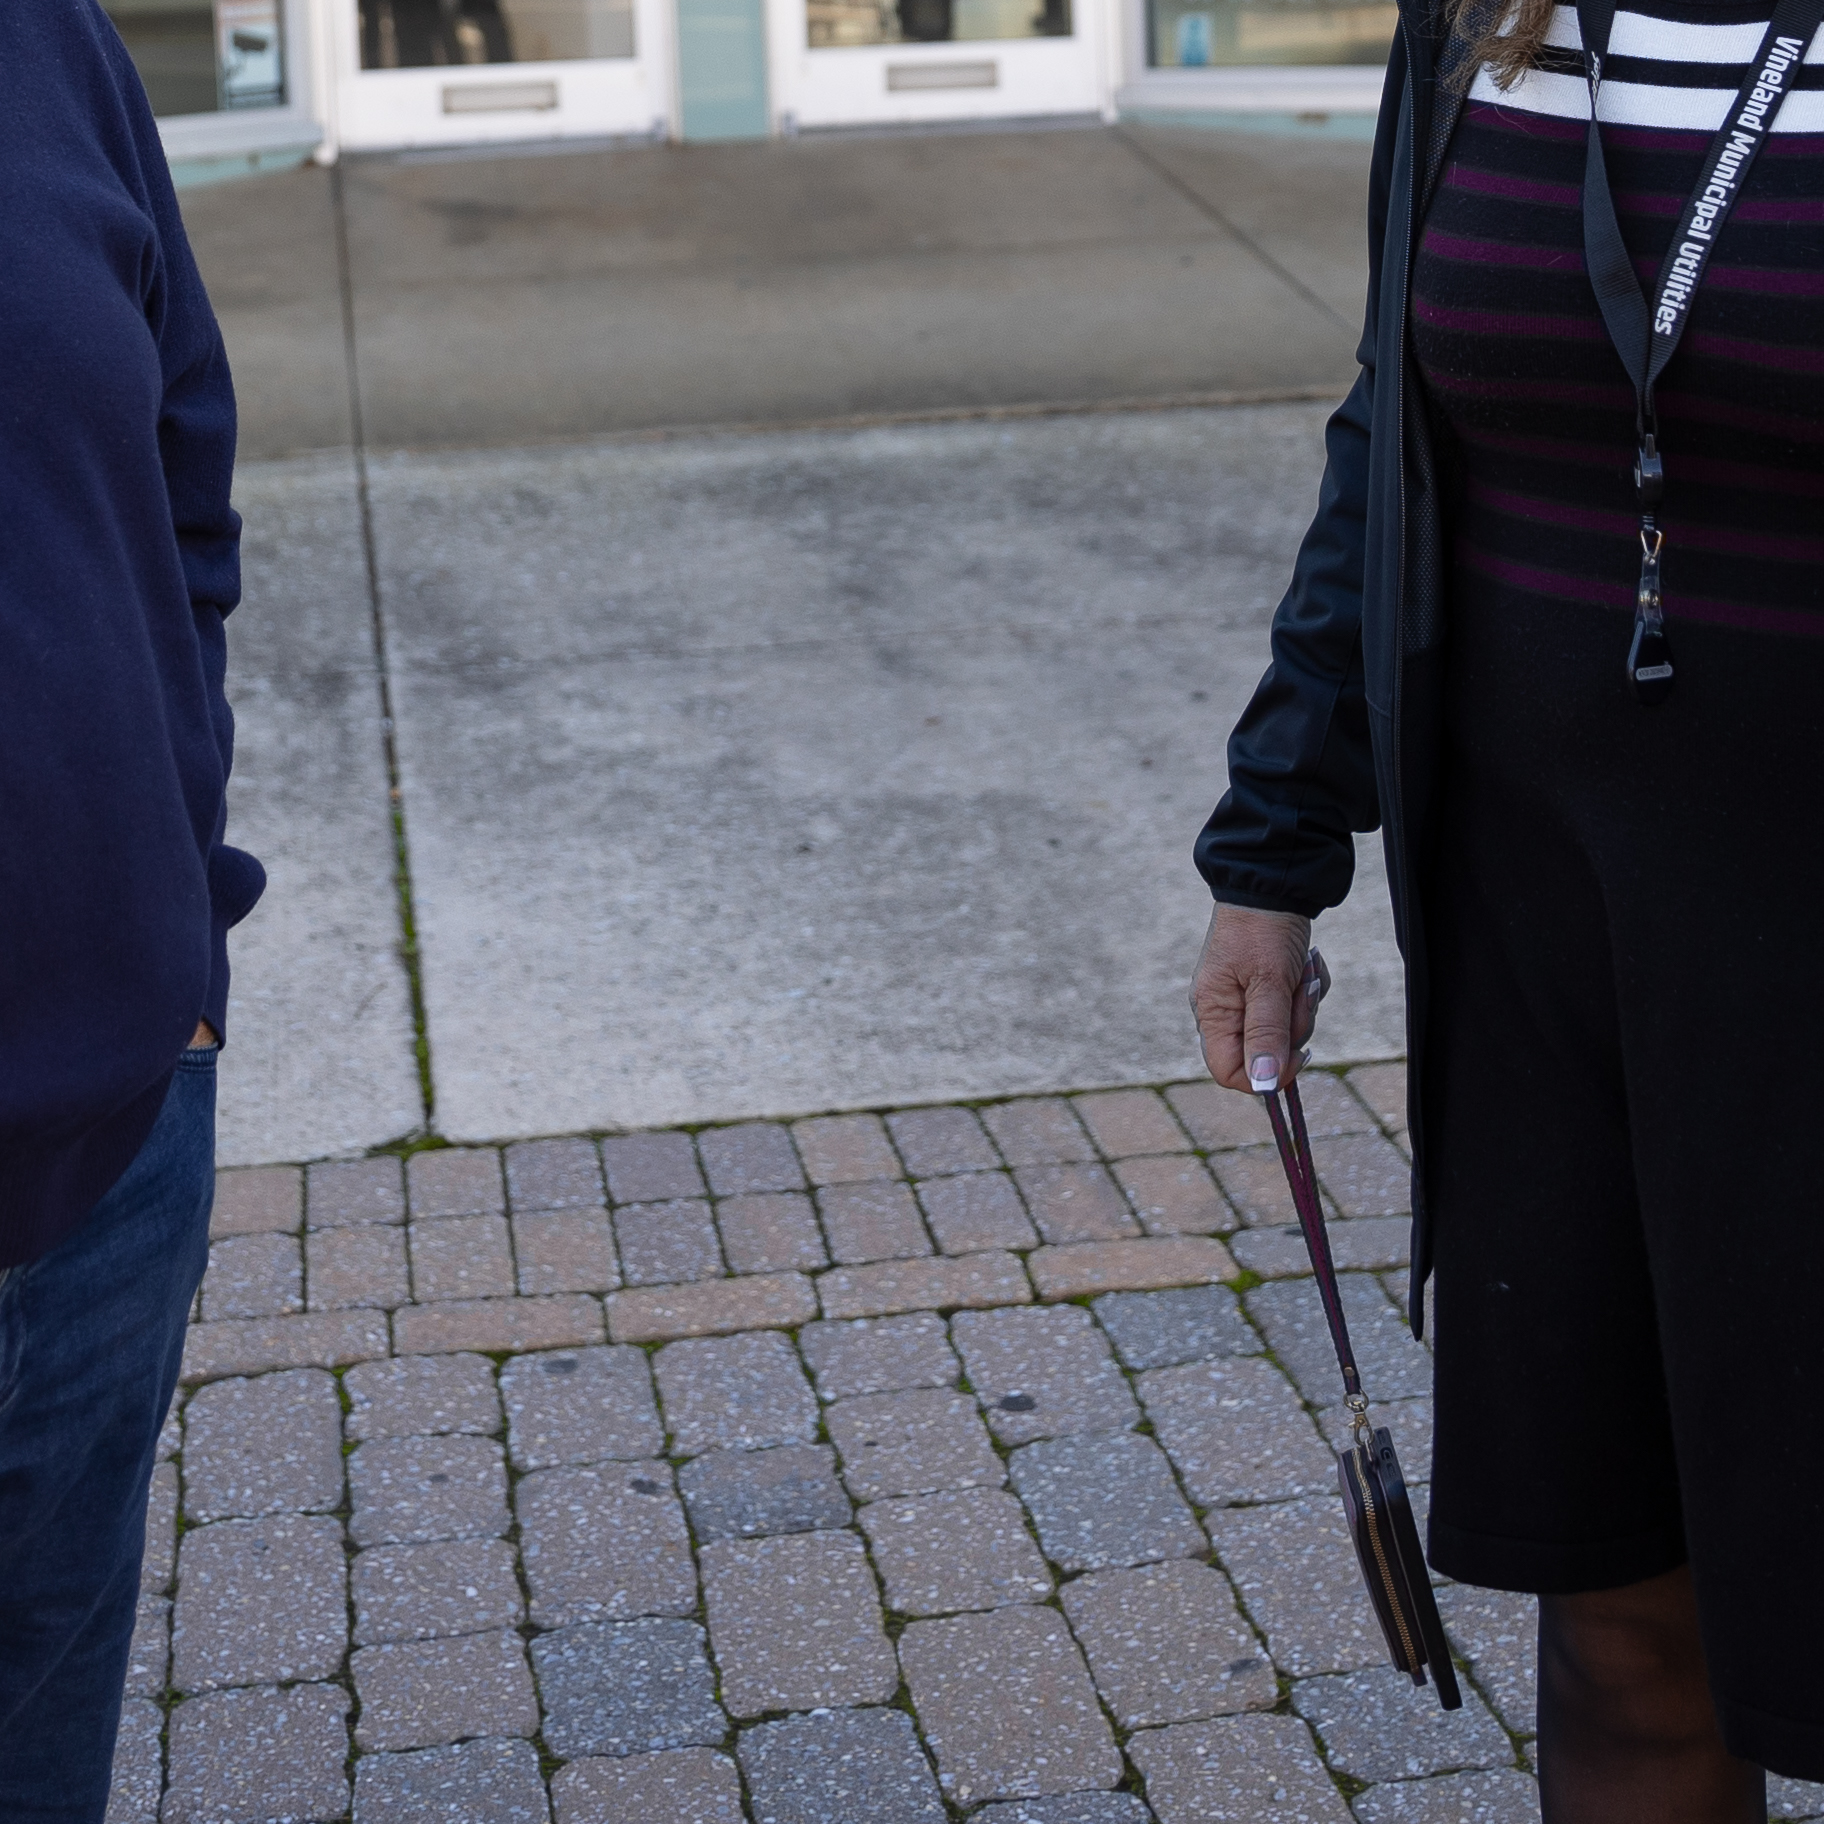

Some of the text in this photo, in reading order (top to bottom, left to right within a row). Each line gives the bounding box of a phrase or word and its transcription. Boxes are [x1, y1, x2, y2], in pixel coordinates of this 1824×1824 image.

[1654, 36, 1804, 335] Vineland Municipal Utilities
